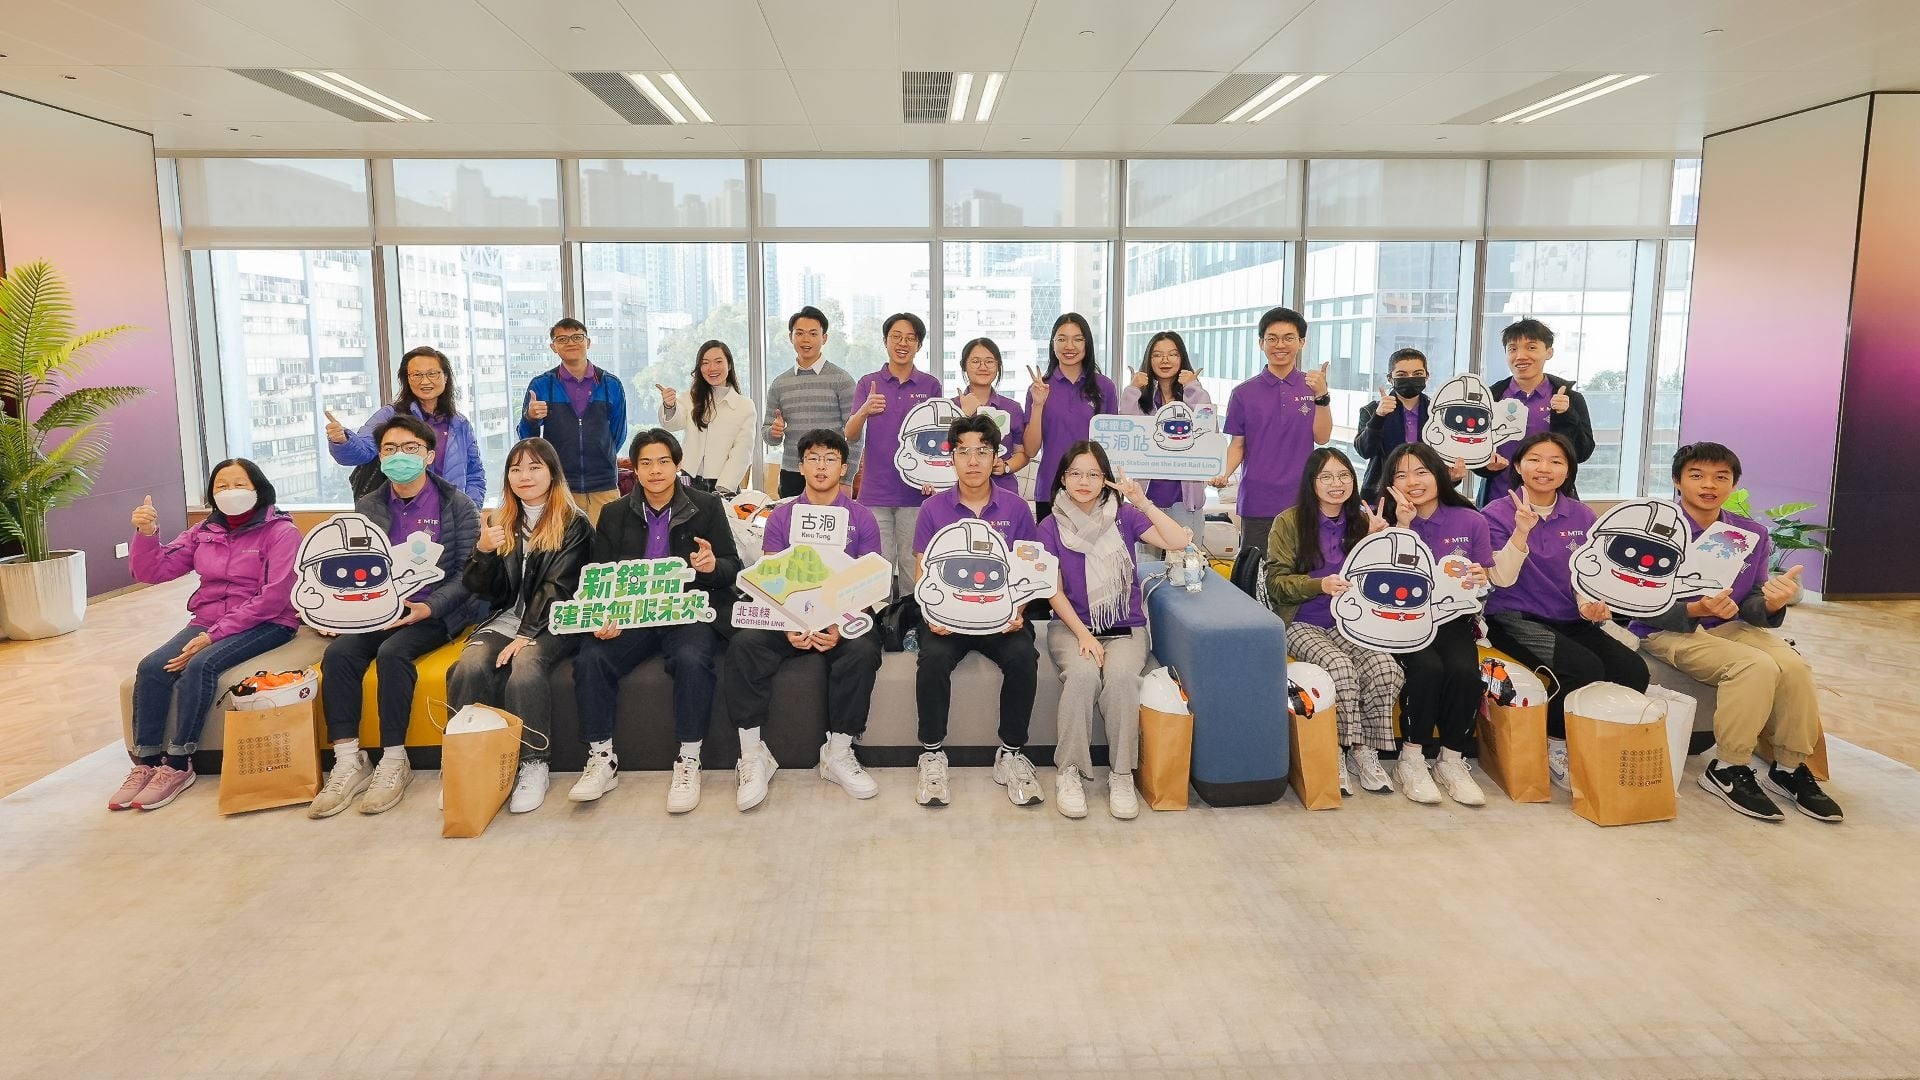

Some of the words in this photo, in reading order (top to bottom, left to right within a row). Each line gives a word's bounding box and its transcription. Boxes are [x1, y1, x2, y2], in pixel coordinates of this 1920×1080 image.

[1094, 433, 1150, 451] 古洞站
[801, 513, 836, 531] 古洞
[816, 532, 831, 540] Tung
[578, 561, 688, 600] 新鐵路
[736, 618, 770, 626] NORTHERN
